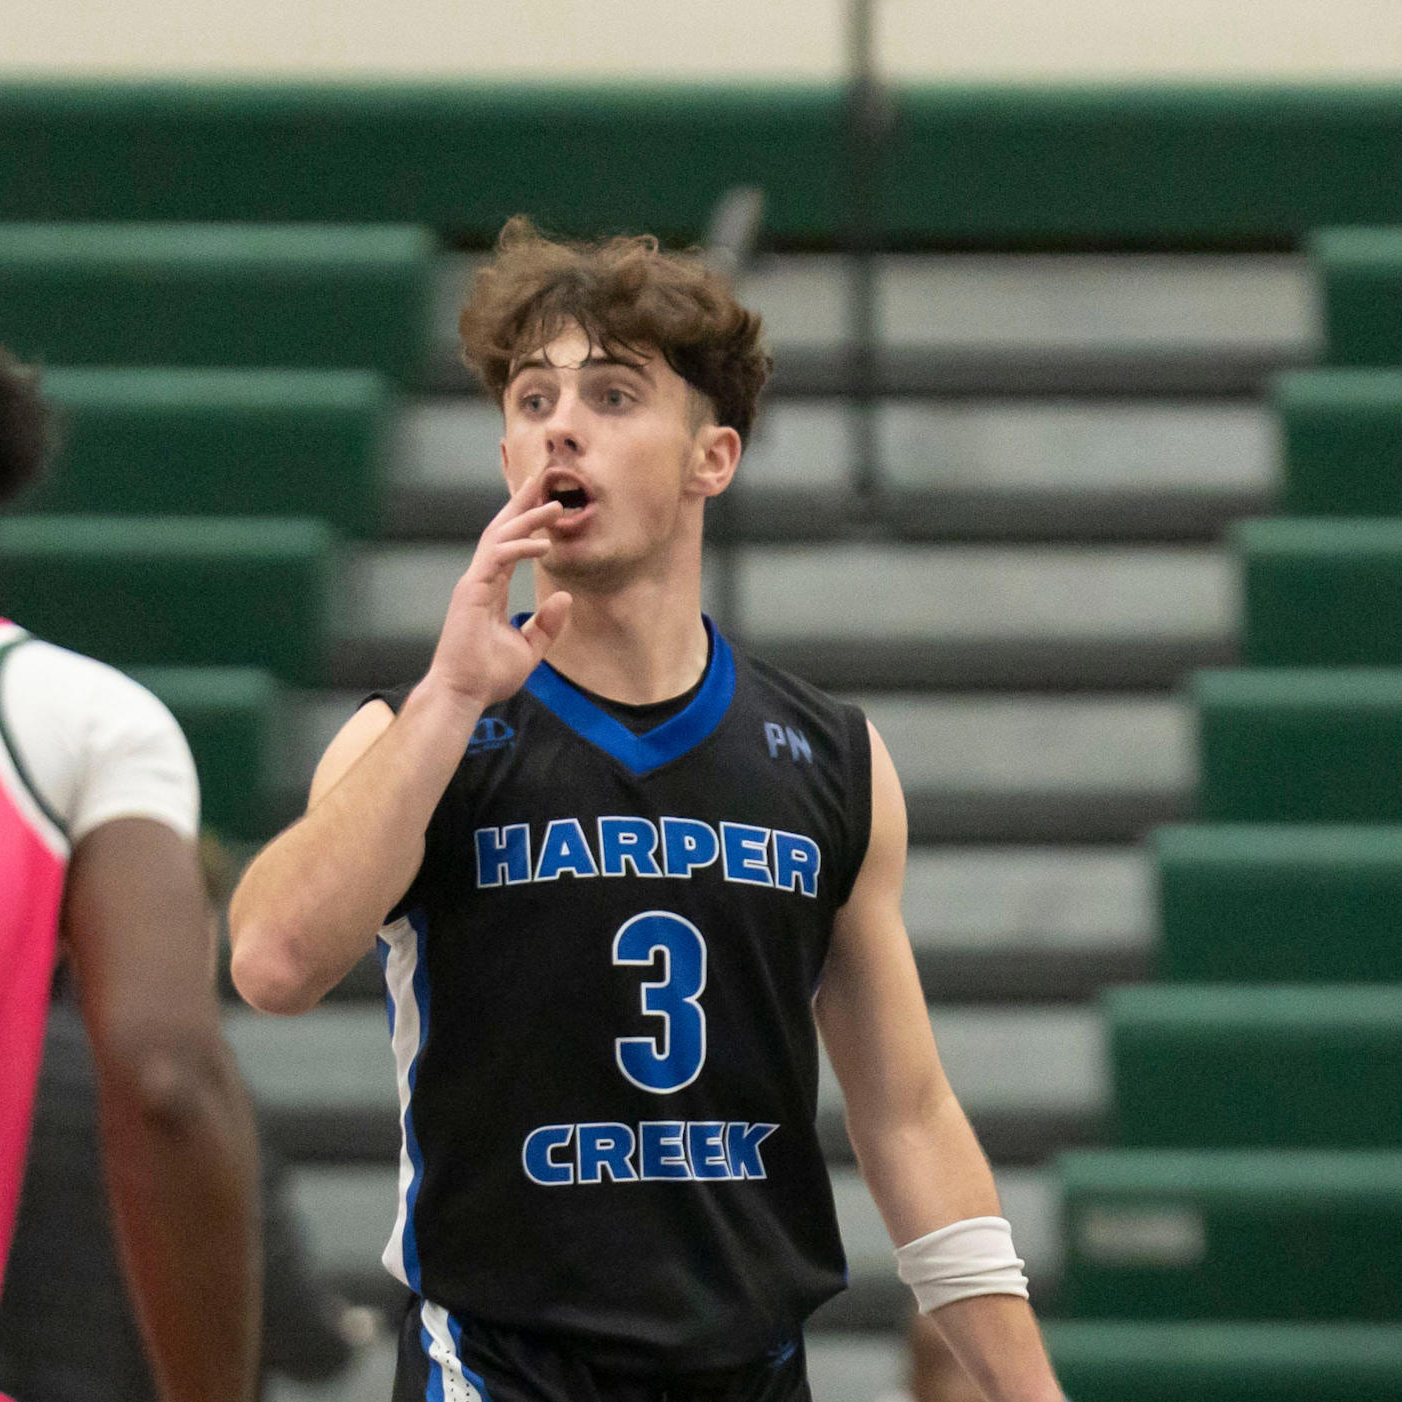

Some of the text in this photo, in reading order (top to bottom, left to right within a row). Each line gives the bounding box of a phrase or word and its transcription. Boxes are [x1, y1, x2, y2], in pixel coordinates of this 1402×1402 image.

[764, 721, 813, 764] PN
[474, 815, 821, 898] HARPER
[612, 910, 708, 1094] 3
[522, 1120, 781, 1186] CREEK
